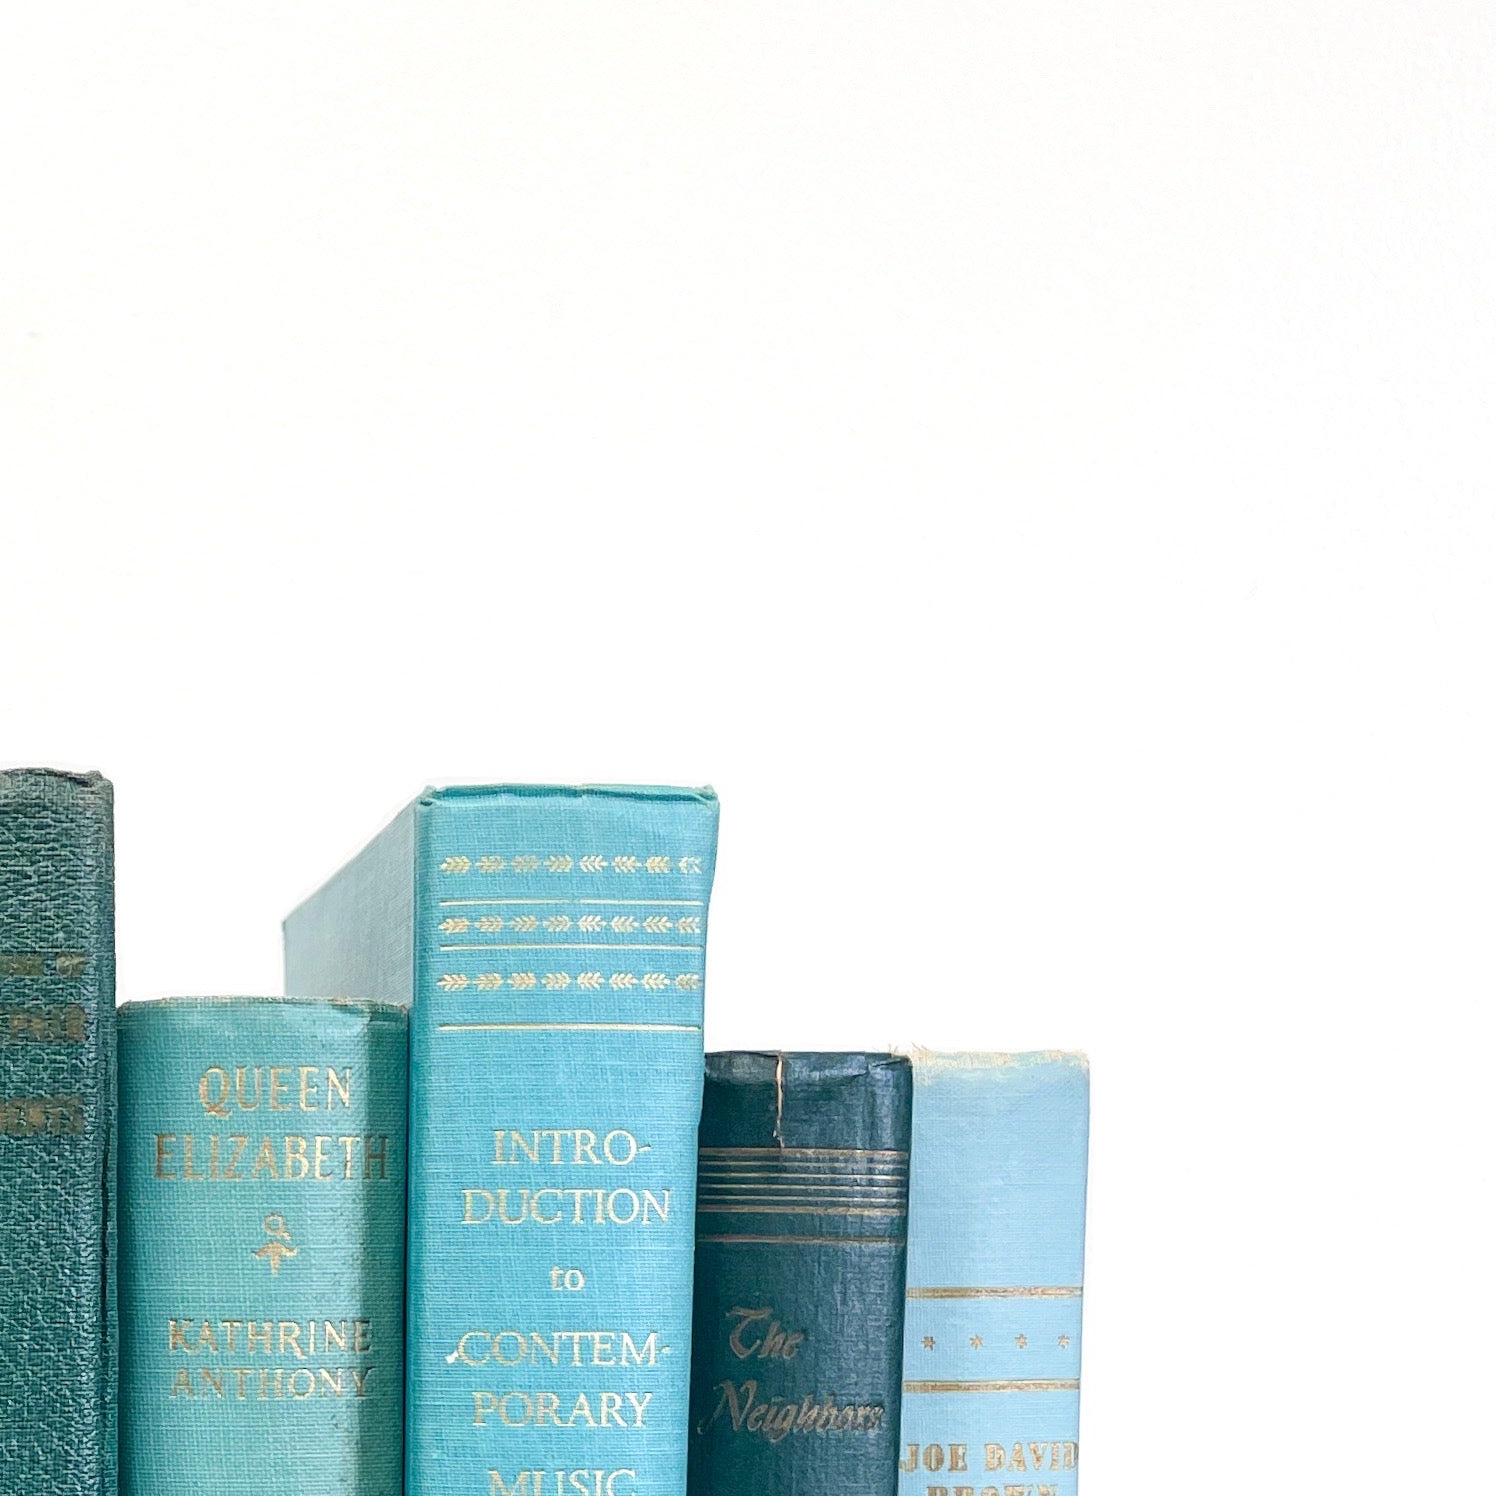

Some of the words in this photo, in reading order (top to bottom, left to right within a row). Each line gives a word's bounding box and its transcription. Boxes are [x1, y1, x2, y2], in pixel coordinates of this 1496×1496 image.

[198, 1065, 352, 1118] QUEEN
[154, 1133, 390, 1180] ELIZABETH
[493, 1128, 652, 1166] INTRO-
[460, 1187, 672, 1225] DUCTION
[548, 1266, 585, 1291] to
[168, 1318, 372, 1360] KATHRINE
[456, 1330, 672, 1367] CONTEM-
[725, 1305, 803, 1360] The
[168, 1366, 376, 1399] ANTHONY
[471, 1390, 654, 1428] PORARY
[899, 1443, 969, 1473] JOE
[984, 1440, 1080, 1473] DAVID
